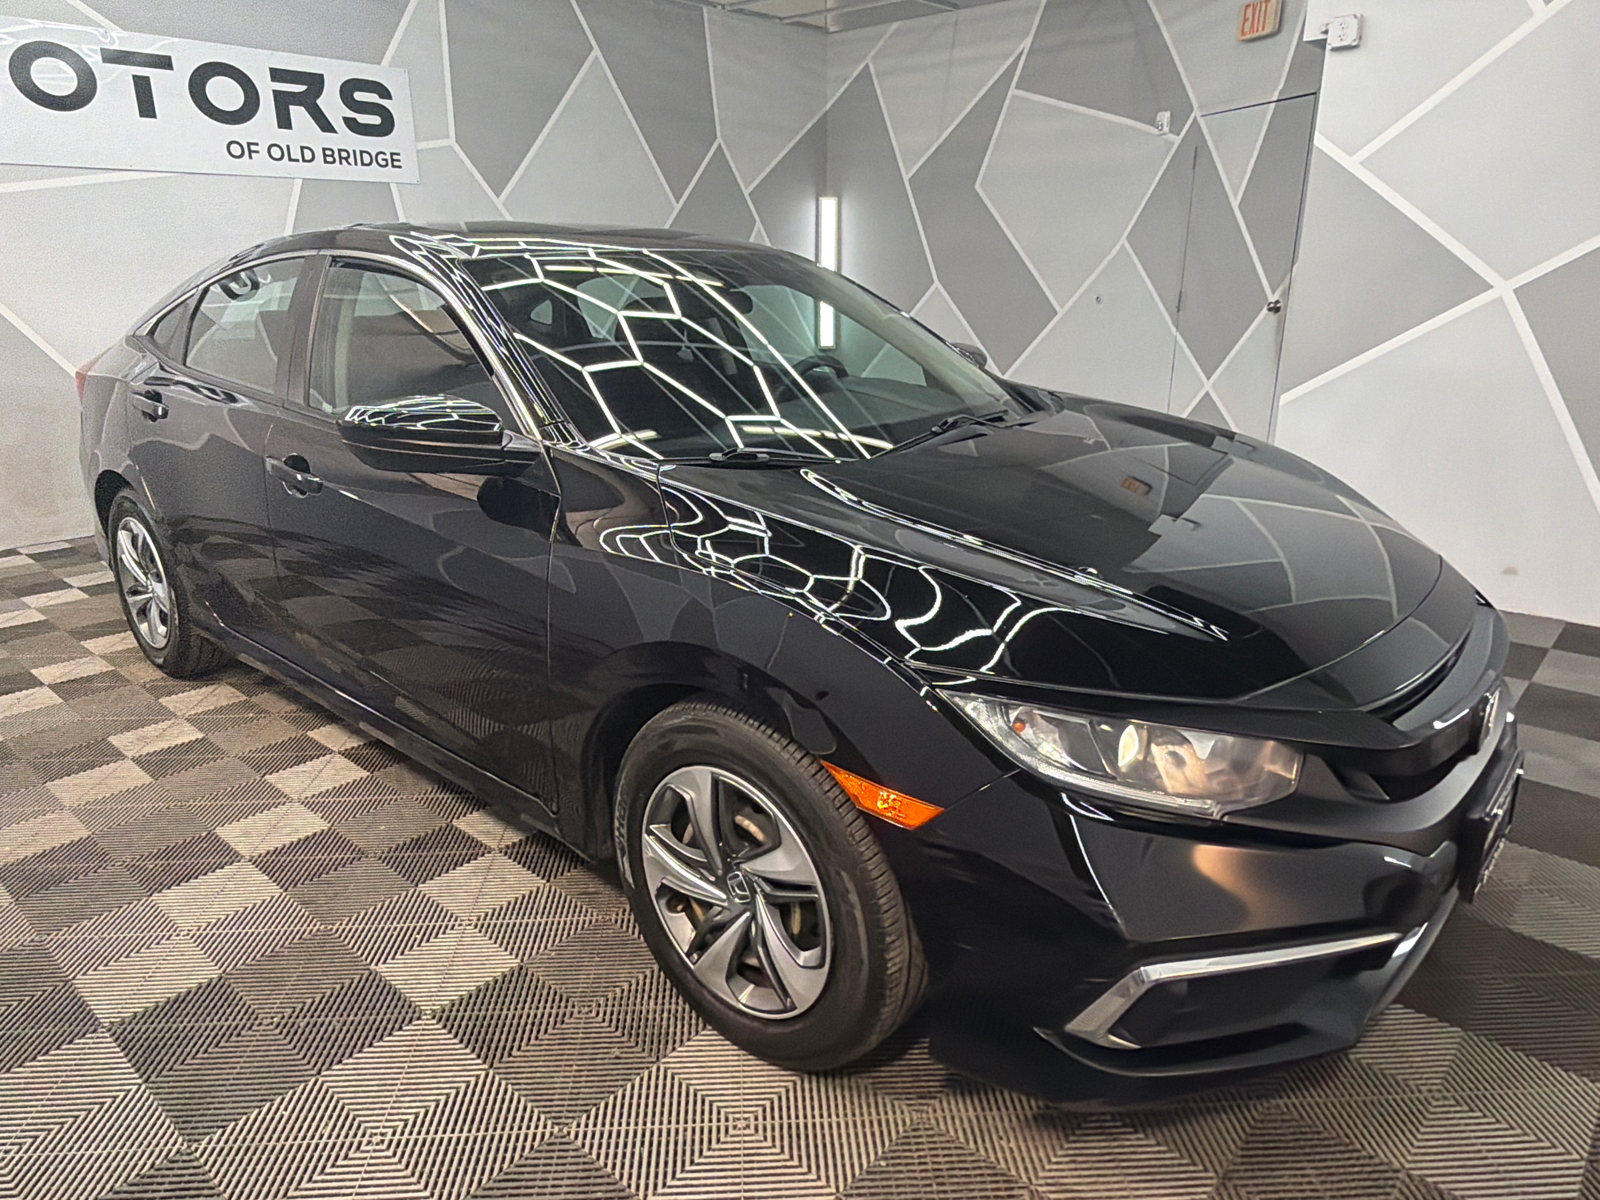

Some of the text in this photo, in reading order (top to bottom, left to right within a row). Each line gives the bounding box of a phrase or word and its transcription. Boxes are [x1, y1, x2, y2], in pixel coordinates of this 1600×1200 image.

[1240, 0, 1271, 37] EXIT
[8, 40, 395, 138] OTORS
[226, 140, 402, 169] OF OLD BRIDGE
